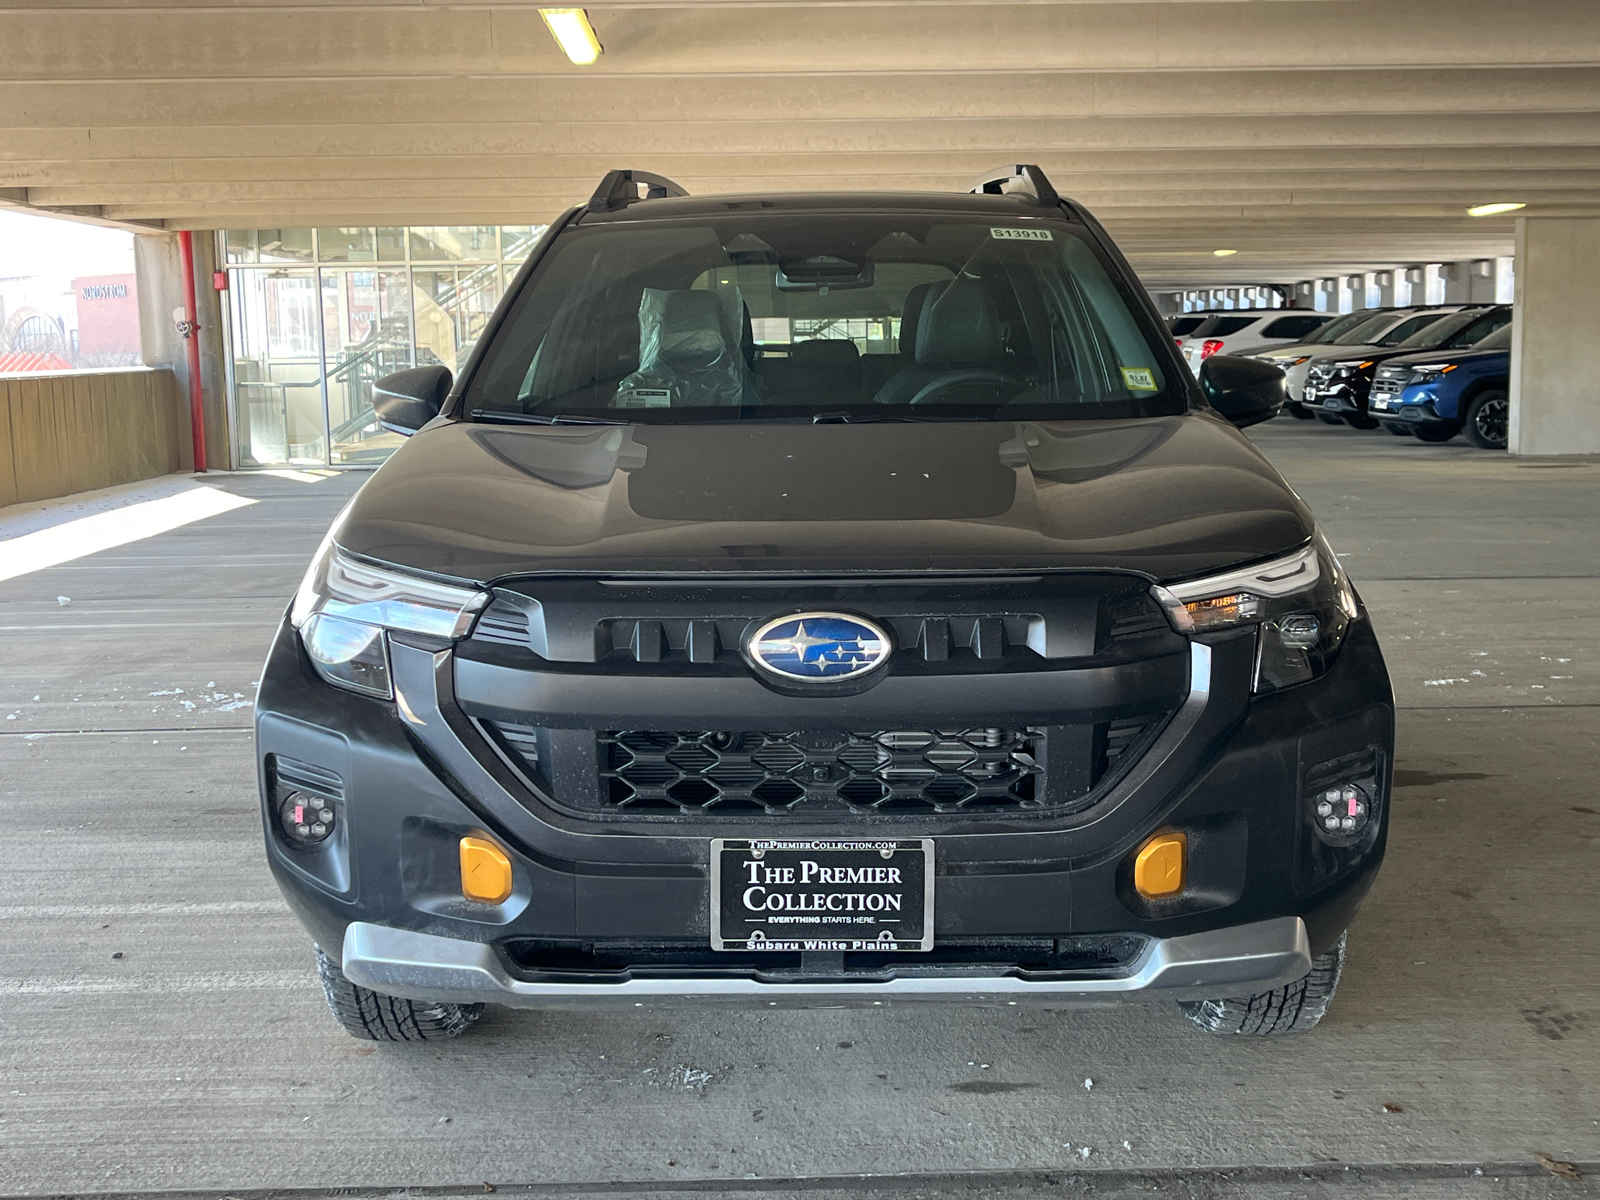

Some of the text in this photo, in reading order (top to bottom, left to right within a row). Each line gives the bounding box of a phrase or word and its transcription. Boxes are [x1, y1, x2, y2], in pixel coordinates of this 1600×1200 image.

[993, 229, 1048, 239] S13918
[81, 285, 127, 300] NORDSTROM
[799, 860, 903, 884] PREMIER
[742, 885, 903, 911] COLLECTION
[768, 916, 820, 924] EVERYTHING
[821, 916, 852, 924] STARTS
[746, 940, 898, 950] Subaru White Plains
